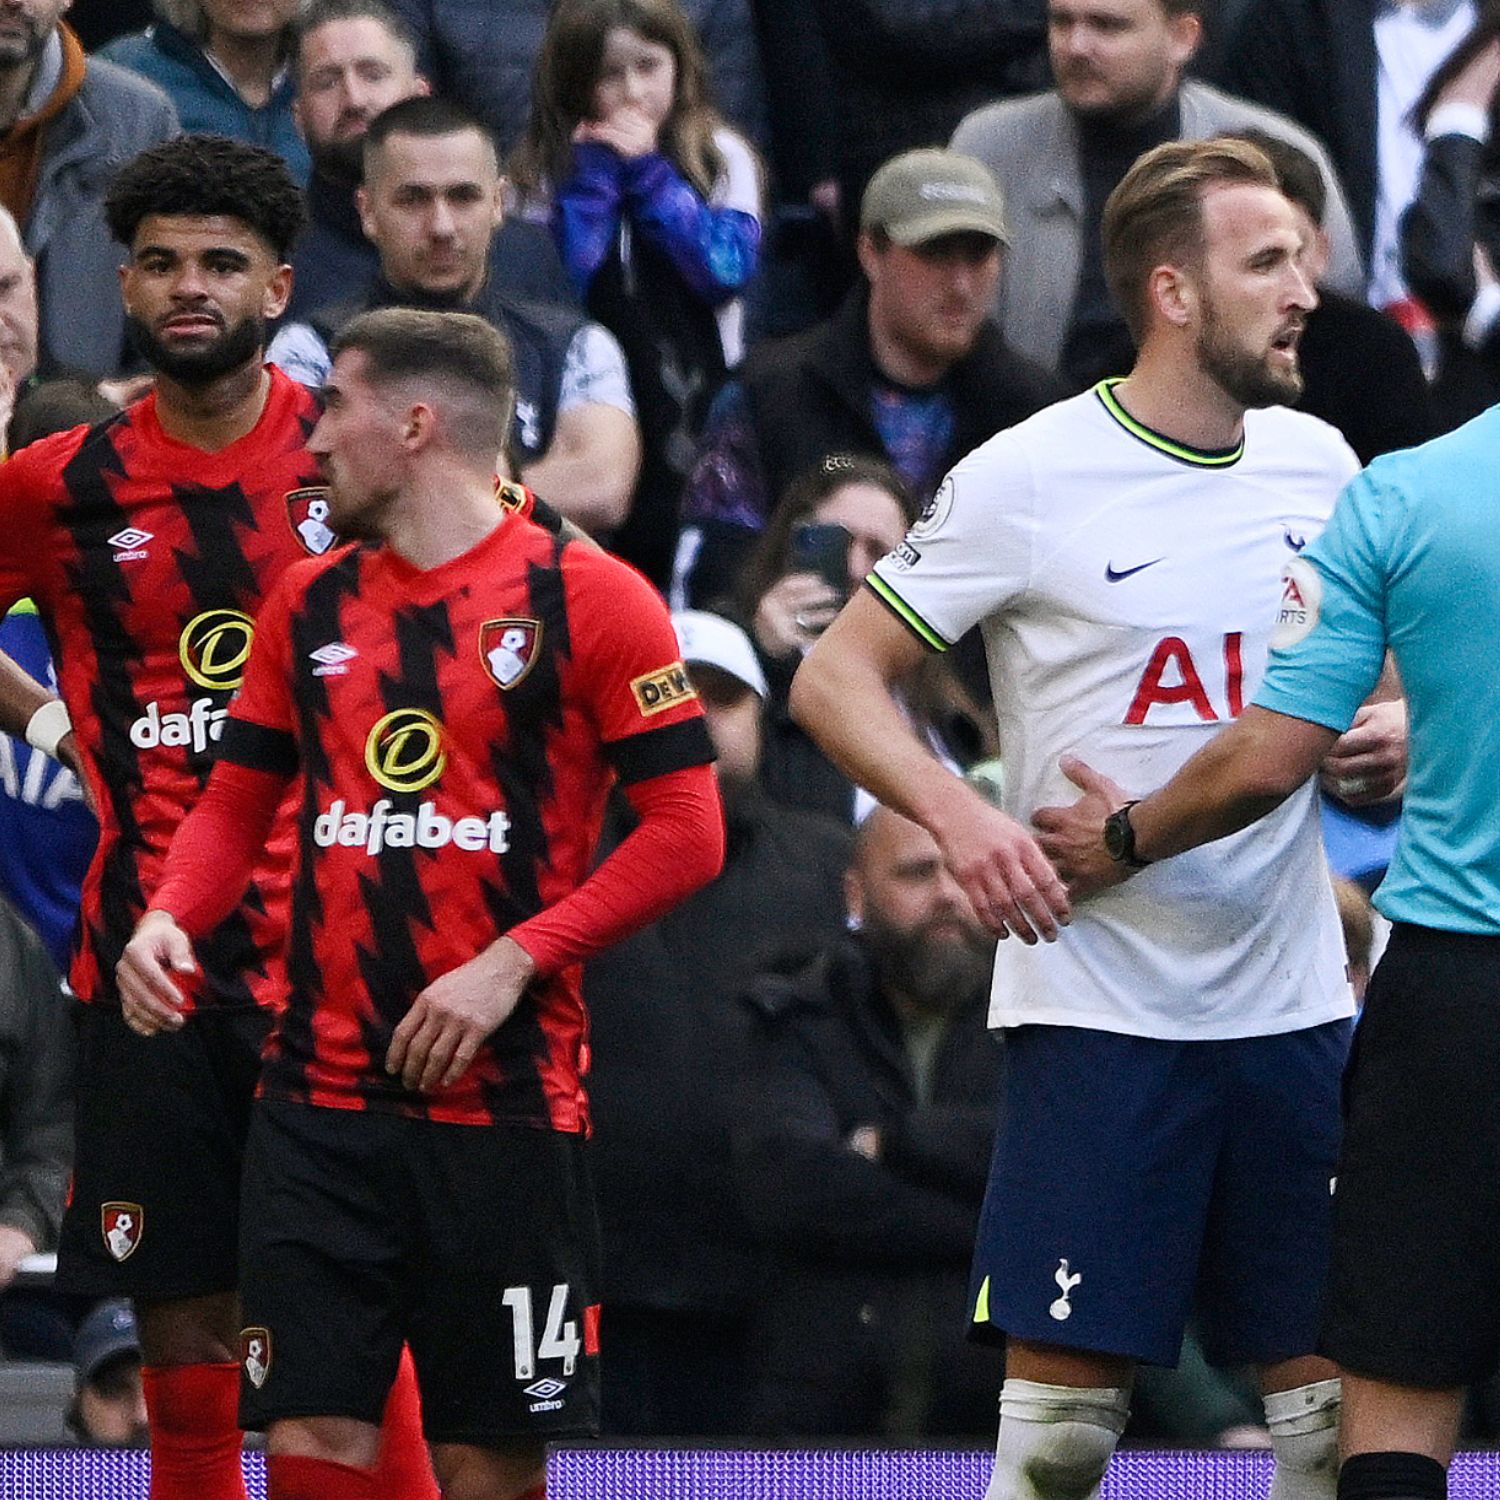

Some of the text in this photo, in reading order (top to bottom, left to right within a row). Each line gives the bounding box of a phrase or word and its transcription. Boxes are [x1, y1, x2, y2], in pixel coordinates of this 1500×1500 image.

[1281, 577, 1306, 608] A
[1276, 609, 1306, 625] RTS
[639, 669, 686, 706] DEW
[1122, 632, 1244, 725] AI
[130, 698, 229, 753] dafa
[314, 800, 511, 855] dafabet
[502, 1284, 580, 1379] 14
[529, 1400, 563, 1412] umbro
